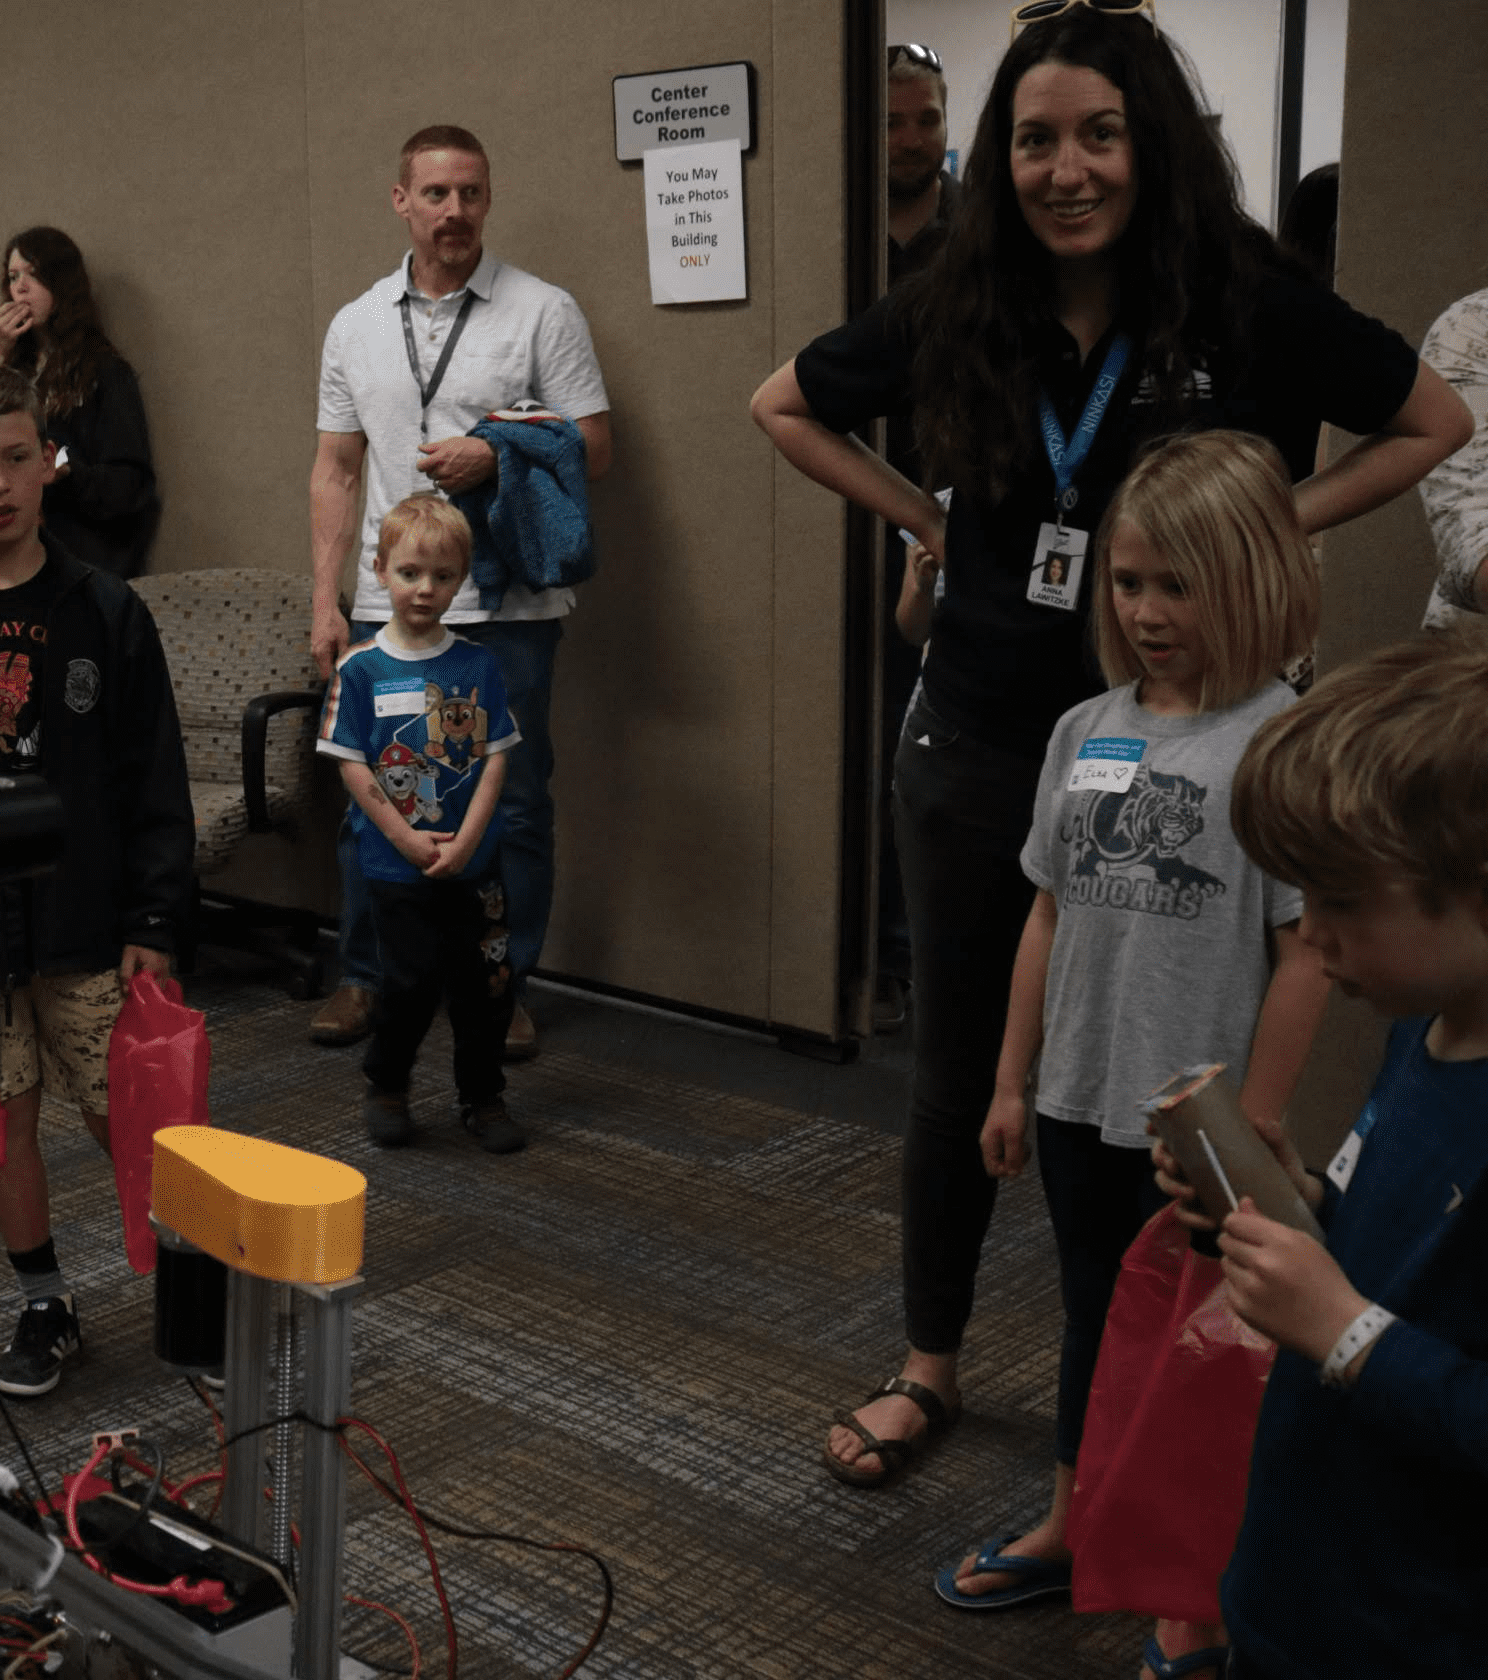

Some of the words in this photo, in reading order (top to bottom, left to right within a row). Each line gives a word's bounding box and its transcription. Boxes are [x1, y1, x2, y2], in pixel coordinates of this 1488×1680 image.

[651, 84, 709, 103] Center
[632, 103, 731, 125] Conference
[658, 125, 706, 142] Room
[666, 169, 689, 183] You
[692, 167, 719, 183] May
[657, 192, 685, 206] Take
[688, 188, 729, 204] Photos
[674, 212, 686, 226] in
[689, 211, 712, 225] This
[671, 233, 718, 248] Building
[679, 255, 711, 269] ONLY
[1081, 373, 1116, 434] NINKASI
[1066, 872, 1202, 921] COUGARS
